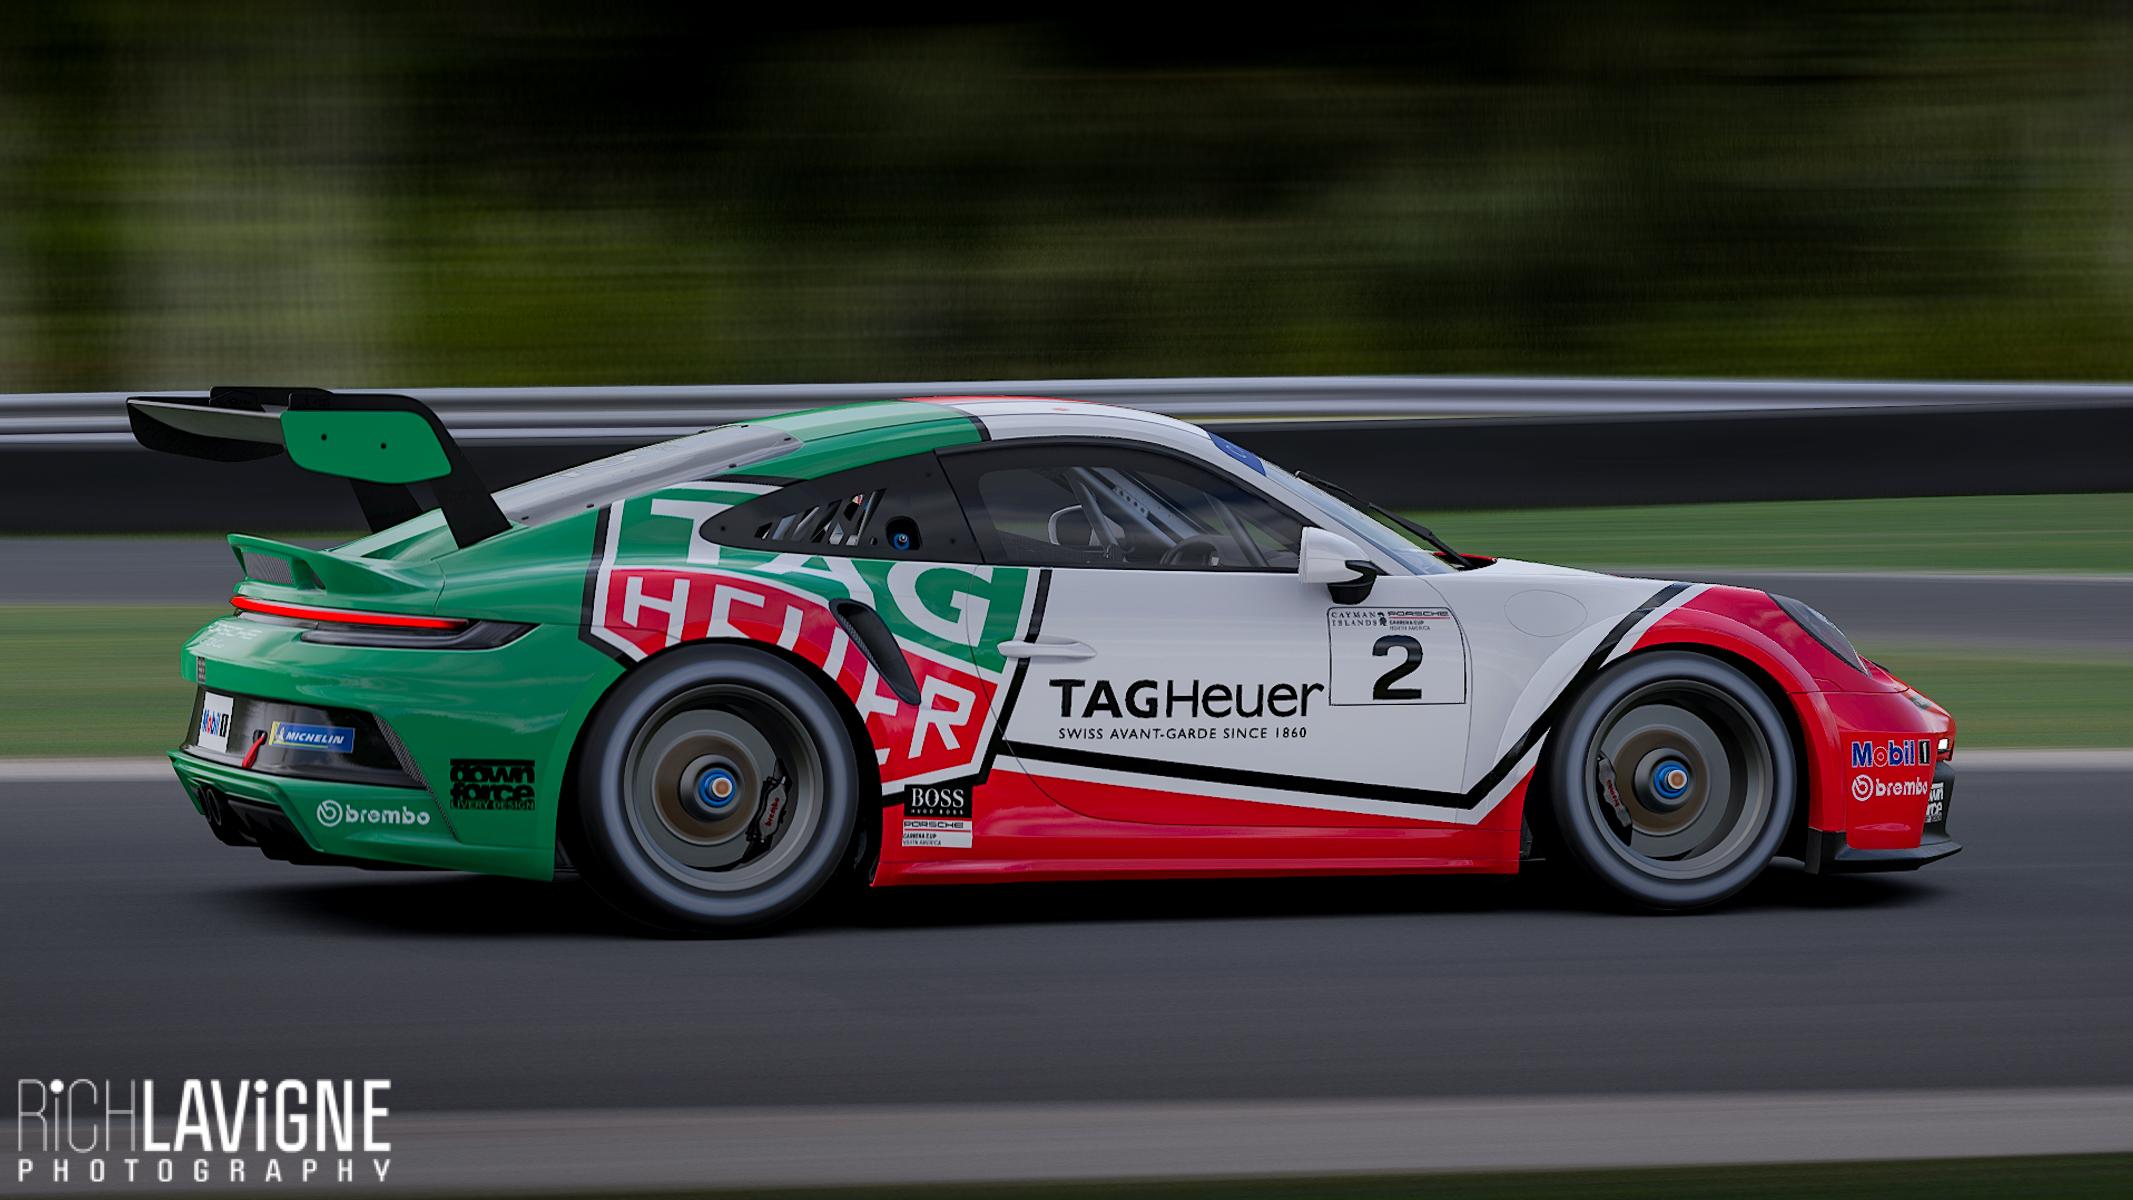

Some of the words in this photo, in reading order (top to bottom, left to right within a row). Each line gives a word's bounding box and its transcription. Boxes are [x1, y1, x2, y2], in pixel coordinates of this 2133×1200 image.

[650, 498, 994, 647] TAG
[1331, 611, 1376, 619] CAYMAN
[1372, 635, 1423, 700] 2
[285, 732, 345, 745] MICHELIN
[1058, 727, 1104, 739] SWISS
[1109, 727, 1217, 739] AVANT-GARDE
[1223, 727, 1268, 739] SINCE
[1275, 726, 1307, 739] 1860
[1851, 740, 1915, 768] Mobil
[1918, 739, 1931, 767] 1
[450, 762, 535, 784] down
[450, 782, 535, 801] force
[1875, 776, 1928, 797] brembo
[911, 788, 964, 808] BOSS
[345, 805, 431, 826] brembo
[904, 821, 964, 829] PORSCHE
